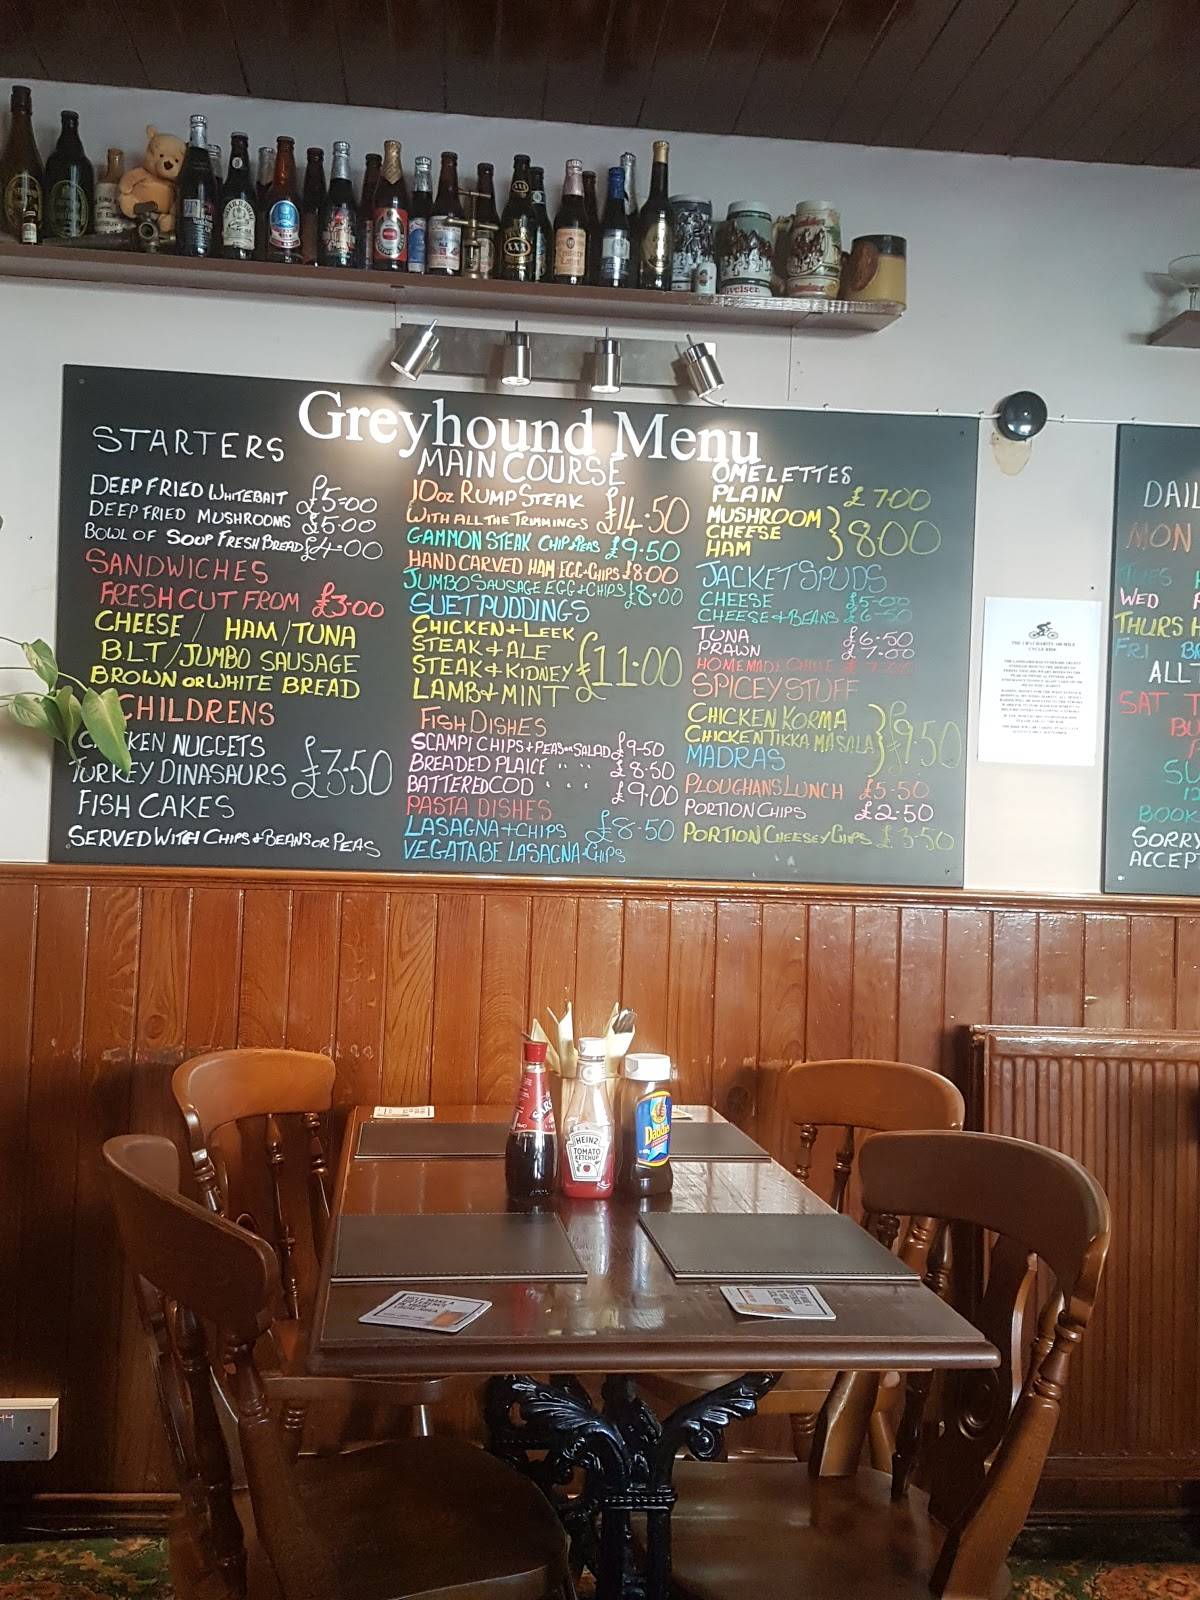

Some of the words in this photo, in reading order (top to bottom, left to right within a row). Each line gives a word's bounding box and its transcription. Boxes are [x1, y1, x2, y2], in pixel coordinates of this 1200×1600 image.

[298, 390, 596, 458] Greyhound
[612, 411, 760, 465] Menu
[93, 426, 285, 462] STARTERS
[417, 448, 495, 478] MAIN
[503, 452, 625, 486] COURSE
[712, 464, 852, 485] OMELETTES
[90, 474, 142, 495] DEEP
[146, 477, 203, 498] FRIED
[209, 484, 288, 504] WHITEBAIT
[460, 480, 517, 506] RUMP
[519, 484, 584, 509] STEAK
[712, 484, 783, 503] PLAIN
[89, 501, 139, 520] DEEP
[143, 505, 185, 521] FRIED
[198, 509, 291, 528] MUSHROOMS
[454, 513, 483, 525] ALL
[513, 511, 588, 530] TRIMMINGS
[707, 505, 821, 528] MUSHROOM
[84, 523, 127, 541] BOWL
[133, 527, 155, 541] OF
[167, 530, 213, 546] SOUP
[218, 531, 259, 549] FRESH
[263, 535, 303, 552] BREAD
[407, 527, 481, 550] GAMMON
[486, 531, 532, 552] STEAK
[706, 525, 780, 540] CHEESE
[706, 540, 751, 557] HAM
[85, 548, 268, 583] SANDWICHES
[408, 550, 455, 571] HAND
[458, 554, 522, 575] CARVED
[528, 559, 555, 578] HAM
[696, 561, 798, 590] JACKET
[798, 560, 887, 593] SPUDS
[403, 567, 469, 590] JUMBO
[471, 574, 540, 595] SAUSAGE
[100, 581, 173, 609] FRESH
[178, 587, 237, 611] CUT
[243, 589, 299, 612] FROM
[410, 592, 478, 617] SUET
[480, 595, 590, 622] PUDDINGS
[700, 591, 773, 608] CHEESE
[1120, 587, 1159, 609] WED
[95, 610, 184, 637] CHEESE
[225, 617, 277, 642] HAM
[412, 615, 504, 636] CHICKEN
[524, 621, 574, 641] LEEK
[698, 609, 768, 623] CHEESE
[1114, 611, 1184, 638] THURS
[692, 625, 749, 643] TUNA
[412, 635, 483, 656] STEAK
[507, 640, 552, 660] ALE
[697, 642, 760, 656] PRAWN
[260, 650, 360, 673] SAUSAGE
[412, 655, 483, 679] STEAK
[506, 663, 573, 682] KIDNEY
[1149, 661, 1191, 684] ALL
[90, 666, 177, 687] BROWN
[206, 673, 272, 692] WHITE
[282, 676, 360, 699] BREAD
[412, 677, 481, 702] LAMB
[502, 685, 570, 707] MINT
[691, 673, 783, 702] SPICEY
[785, 678, 861, 703] STUFF
[118, 693, 275, 726] CHILDRENS
[1119, 691, 1169, 715] SAT
[420, 706, 466, 732] FISH
[470, 709, 547, 737] DISHES
[688, 702, 777, 729] CHICKEN
[782, 706, 847, 732] KORMA
[172, 734, 265, 758] NUGGETS
[411, 733, 473, 752] SCAMPI
[476, 736, 523, 753] CHIPS
[685, 725, 764, 745] CHICKEN
[764, 729, 809, 749] TIKKA
[409, 755, 490, 773] BREADED
[495, 758, 547, 775] PLAICE
[685, 745, 785, 770] MADRAS
[158, 759, 287, 786] DINASAURS
[407, 775, 488, 794] BATTERED
[489, 777, 533, 796] COD
[783, 775, 844, 799] LUNCH
[79, 789, 130, 818] FISH
[139, 793, 235, 819] CAKES
[407, 796, 468, 816] PASTA
[478, 798, 552, 821] DISHES
[685, 799, 757, 817] PORTION
[757, 802, 806, 820] CHIPS
[405, 816, 502, 837] LASAGNA
[683, 822, 760, 845] PORTION
[68, 825, 151, 847] SERVED
[203, 828, 250, 845] CHIPS
[263, 829, 311, 847] BEANS
[333, 833, 381, 858] PEAS
[508, 842, 580, 864] LASAGNA
[574, 1147, 600, 1155] TOMATO
[576, 1136, 598, 1144] HEINZ
